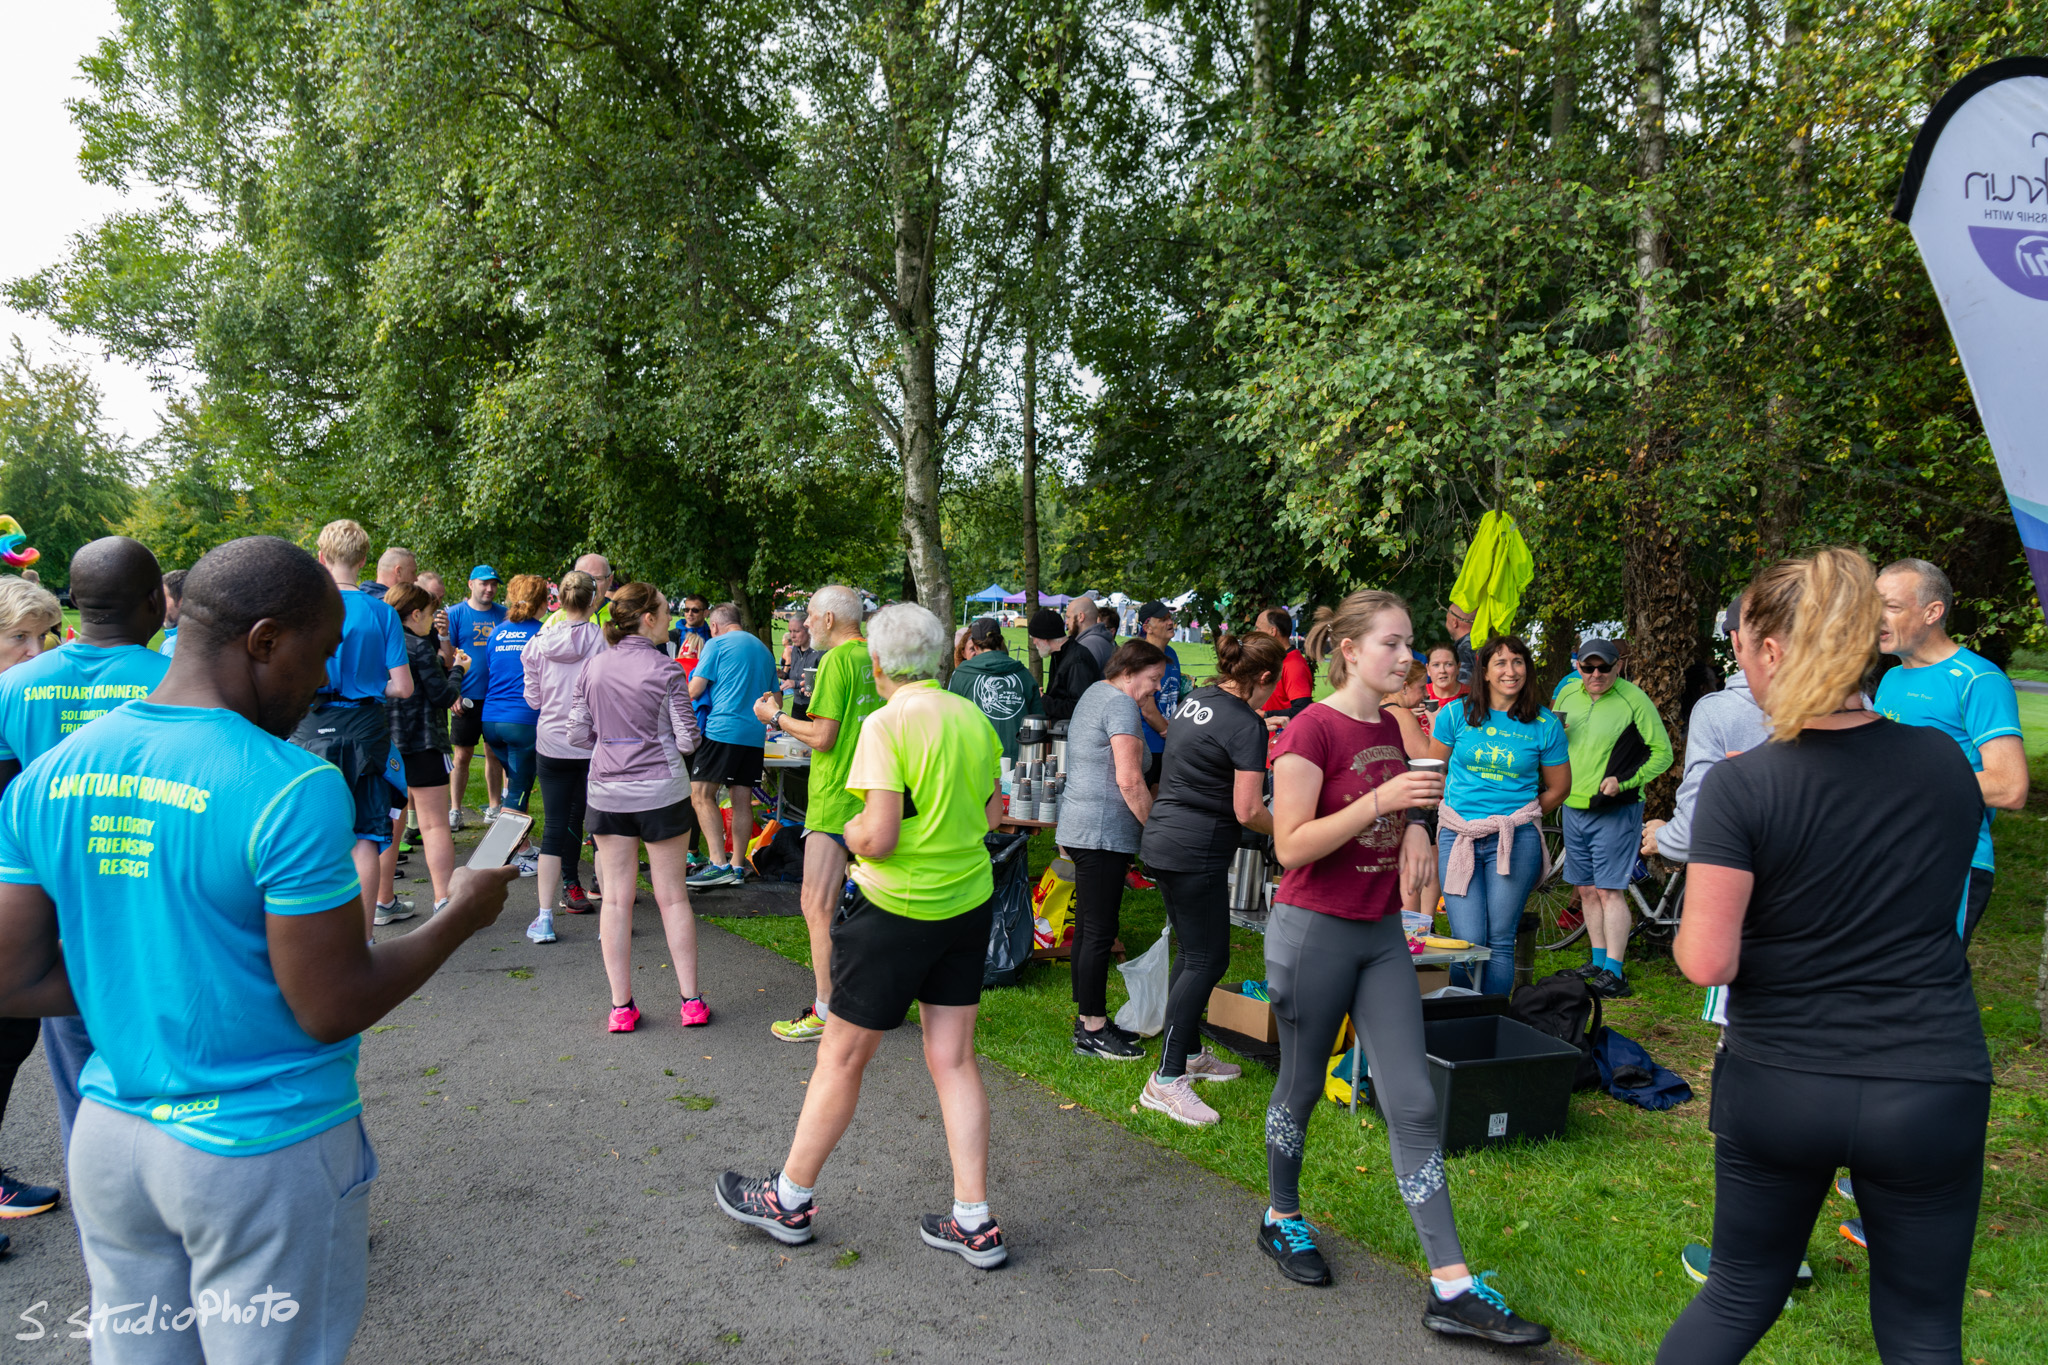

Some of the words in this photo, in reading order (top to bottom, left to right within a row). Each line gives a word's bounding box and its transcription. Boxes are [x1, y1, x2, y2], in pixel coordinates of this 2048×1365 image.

[24, 685, 93, 702] SANCTUARY
[94, 684, 148, 699] RUNNERS
[1174, 697, 1214, 725] 100
[138, 776, 210, 814] RUNNERS
[89, 814, 155, 837] SOLIDRITY
[87, 836, 155, 858] FRIENSHIP
[98, 858, 149, 878] RESECT
